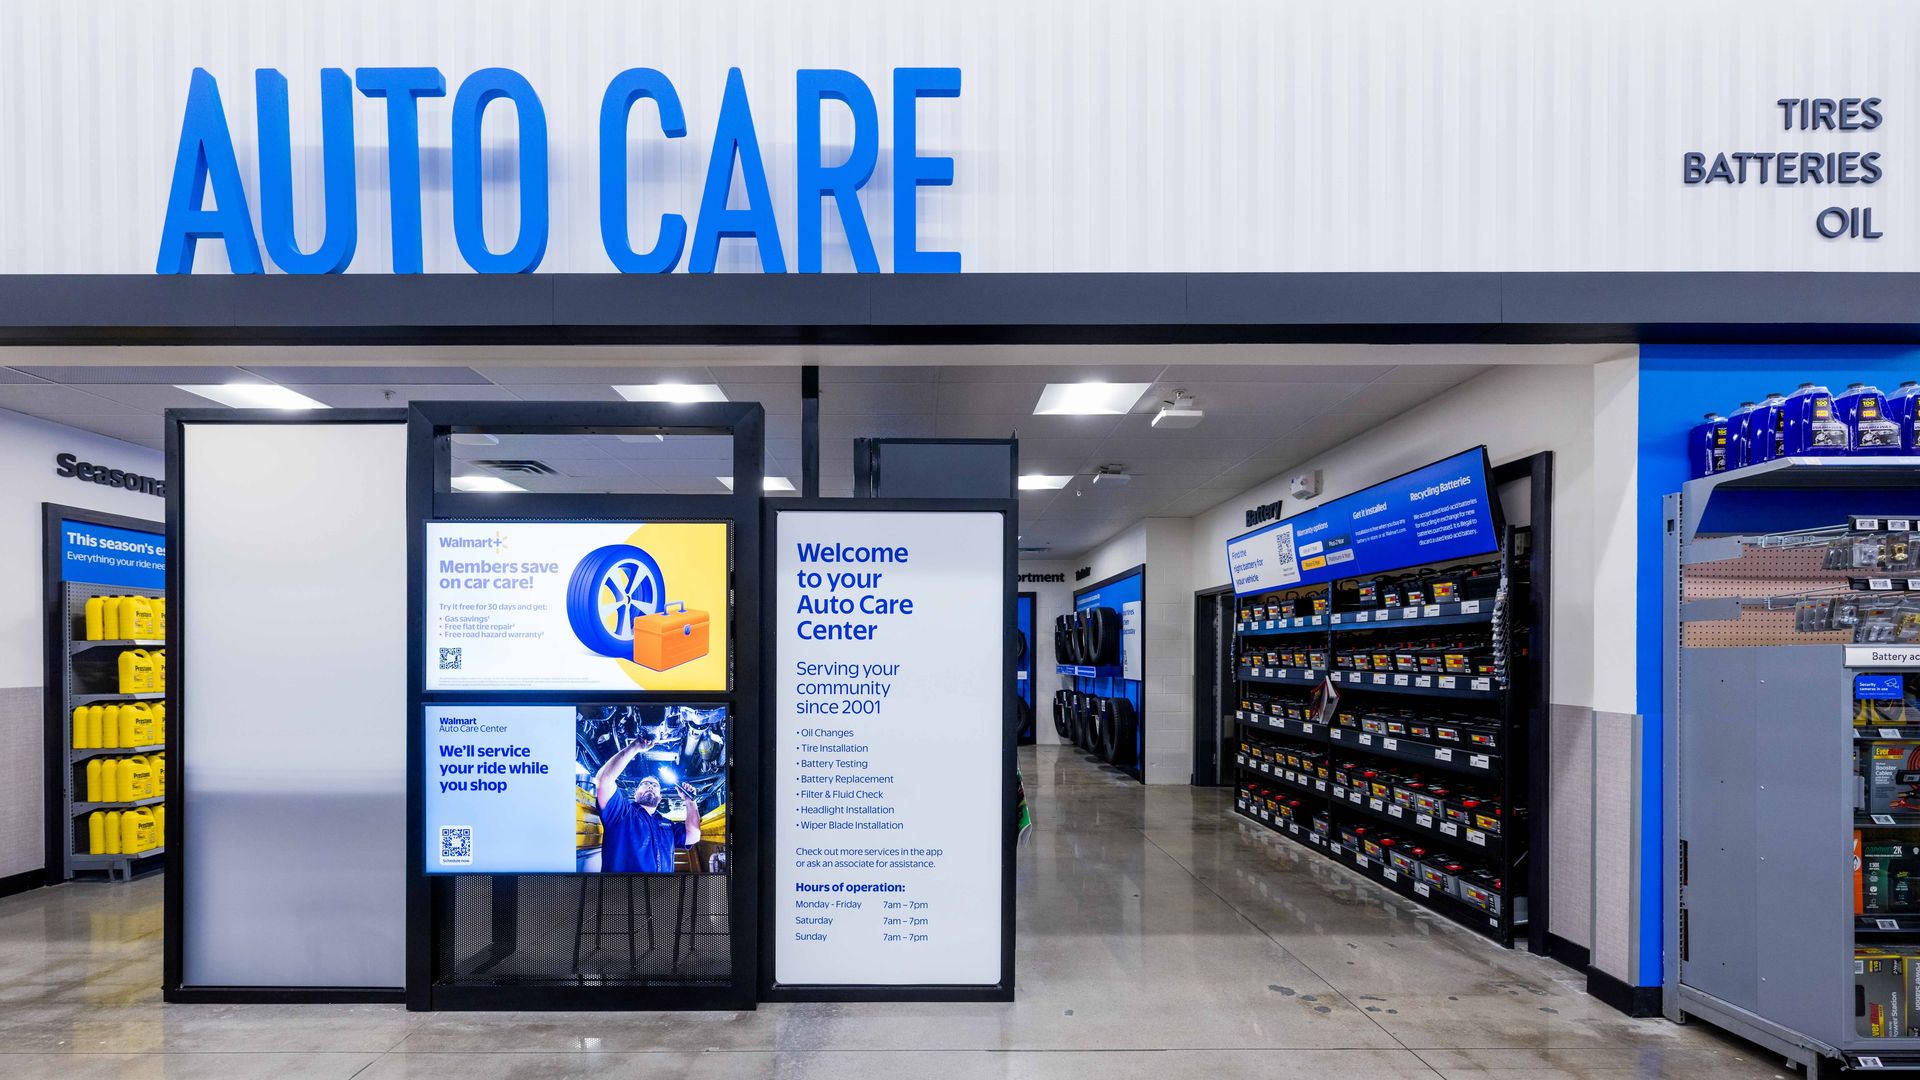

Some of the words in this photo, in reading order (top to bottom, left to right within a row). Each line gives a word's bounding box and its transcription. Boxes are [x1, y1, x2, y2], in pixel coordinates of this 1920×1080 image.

[1777, 97, 1883, 130] TIRES
[156, 67, 549, 274] AUTO
[600, 67, 962, 274] CARE
[1684, 151, 1883, 184] BATTERIES
[1816, 206, 1883, 239] OIL
[1410, 486, 1439, 501] Recycling
[1440, 476, 1471, 493] Batteries
[1246, 500, 1282, 527] Battery
[67, 531, 98, 547] This
[100, 538, 154, 556] season's
[797, 543, 909, 563] Welcome
[67, 551, 115, 566] Everything
[116, 556, 135, 568] your
[136, 559, 152, 570] ride
[440, 560, 518, 574] Members
[521, 562, 559, 573] save
[440, 578, 461, 589] on
[464, 578, 490, 589] car
[493, 576, 534, 589] care!
[797, 569, 822, 588] to
[827, 573, 882, 592] your
[440, 603, 451, 612] Try
[453, 603, 458, 611] it
[459, 603, 475, 611] free
[476, 603, 487, 611] for
[488, 603, 497, 611] 30
[499, 603, 517, 613] days
[518, 603, 532, 611] and
[533, 604, 548, 613] get:
[797, 595, 855, 614] Auto
[859, 595, 914, 614] Care
[444, 615, 458, 623] Gas
[444, 623, 461, 631] Free
[463, 623, 475, 631] flat
[476, 623, 489, 631] tire
[797, 621, 878, 640] Center
[444, 631, 461, 639] Free
[462, 631, 480, 639] road
[481, 631, 507, 639] hazard
[1872, 652, 1907, 663] Battery
[796, 661, 860, 678] Serving
[863, 663, 900, 678] your
[796, 680, 891, 697] community
[796, 700, 839, 714] since
[842, 700, 881, 714] 2001
[439, 717, 477, 725] Walmart
[439, 725, 459, 733] Auto
[460, 725, 479, 733] Care
[480, 725, 508, 733] Center
[801, 728, 813, 737] Oil
[814, 728, 854, 739] Changes
[477, 745, 531, 757] service
[801, 743, 818, 753] Tire
[819, 743, 869, 753] Installation
[439, 764, 474, 777] your
[477, 762, 506, 774] ride
[509, 762, 549, 774] while
[801, 759, 834, 769] Battery
[835, 759, 869, 770] Testing
[801, 774, 834, 784] Battery
[835, 774, 894, 785] Replacement
[439, 780, 467, 794] you
[470, 779, 508, 794] shop
[801, 789, 823, 799] Filter
[824, 790, 831, 799] &
[832, 789, 855, 799] Fluid
[856, 789, 884, 799] Check
[801, 805, 844, 815] Headlight
[845, 805, 895, 814] Installation
[801, 820, 827, 831] Wiper
[829, 820, 854, 830] Blade
[855, 820, 904, 830] Installation
[796, 847, 822, 856] Check
[824, 848, 839, 856] out
[864, 847, 900, 856] services
[900, 847, 909, 856] in
[910, 847, 925, 856] the
[926, 849, 943, 858] app
[796, 860, 806, 868] or
[807, 858, 821, 868] ask
[822, 860, 833, 868] an
[834, 859, 874, 868] associate
[875, 858, 888, 868] for
[889, 859, 936, 868] assistance.
[796, 882, 830, 893] Hours
[832, 882, 845, 893] of
[847, 882, 906, 894] operation:
[796, 900, 830, 909] Monday
[836, 900, 862, 909] Friday
[883, 901, 901, 909] 7am
[909, 901, 928, 910] 7pm
[795, 916, 833, 926] Saturday
[883, 917, 901, 925] 7am
[909, 917, 928, 926] 7pm
[795, 932, 827, 942] Sunday
[883, 933, 901, 942] 7am
[909, 933, 928, 943] 7pm
